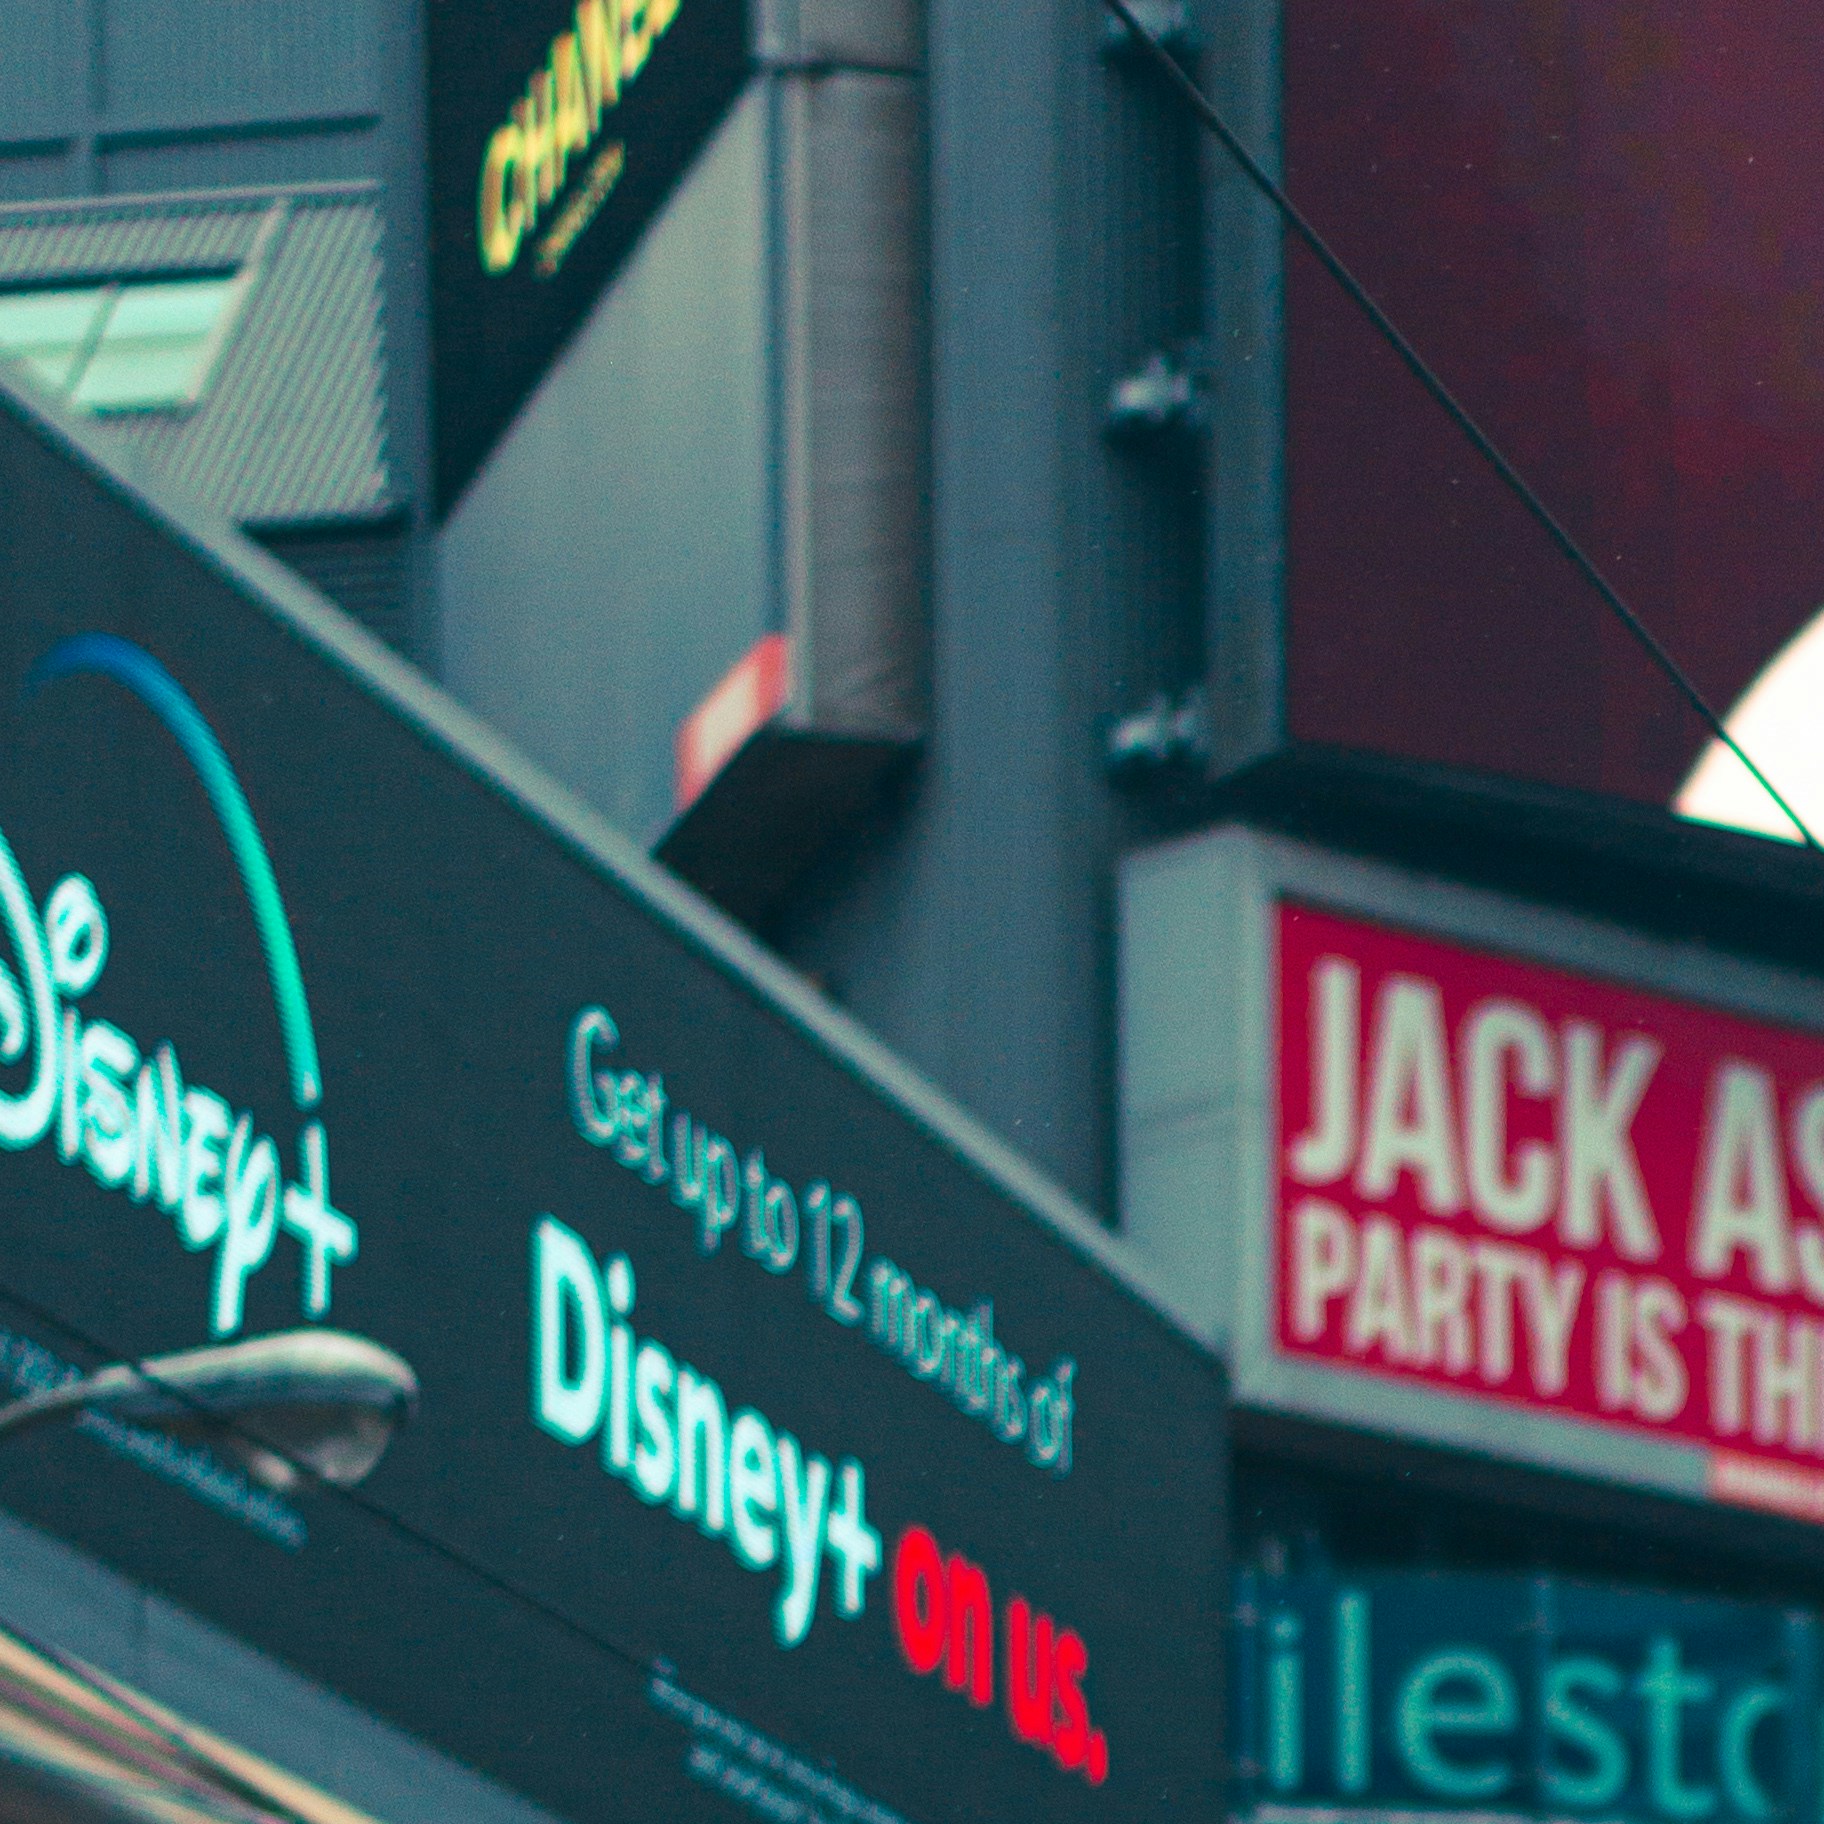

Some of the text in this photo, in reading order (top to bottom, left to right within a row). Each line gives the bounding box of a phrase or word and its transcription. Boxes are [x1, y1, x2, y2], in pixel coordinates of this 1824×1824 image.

[567, 1004, 1078, 1481] Get up to 12 months of
[1291, 954, 1661, 1265] JACK
[531, 1212, 882, 1645] Disney+
[894, 1525, 994, 1708] on
[1007, 1597, 1109, 1785] us.
[1285, 1196, 1585, 1397] PARTY
[1600, 1267, 1691, 1422] IS
